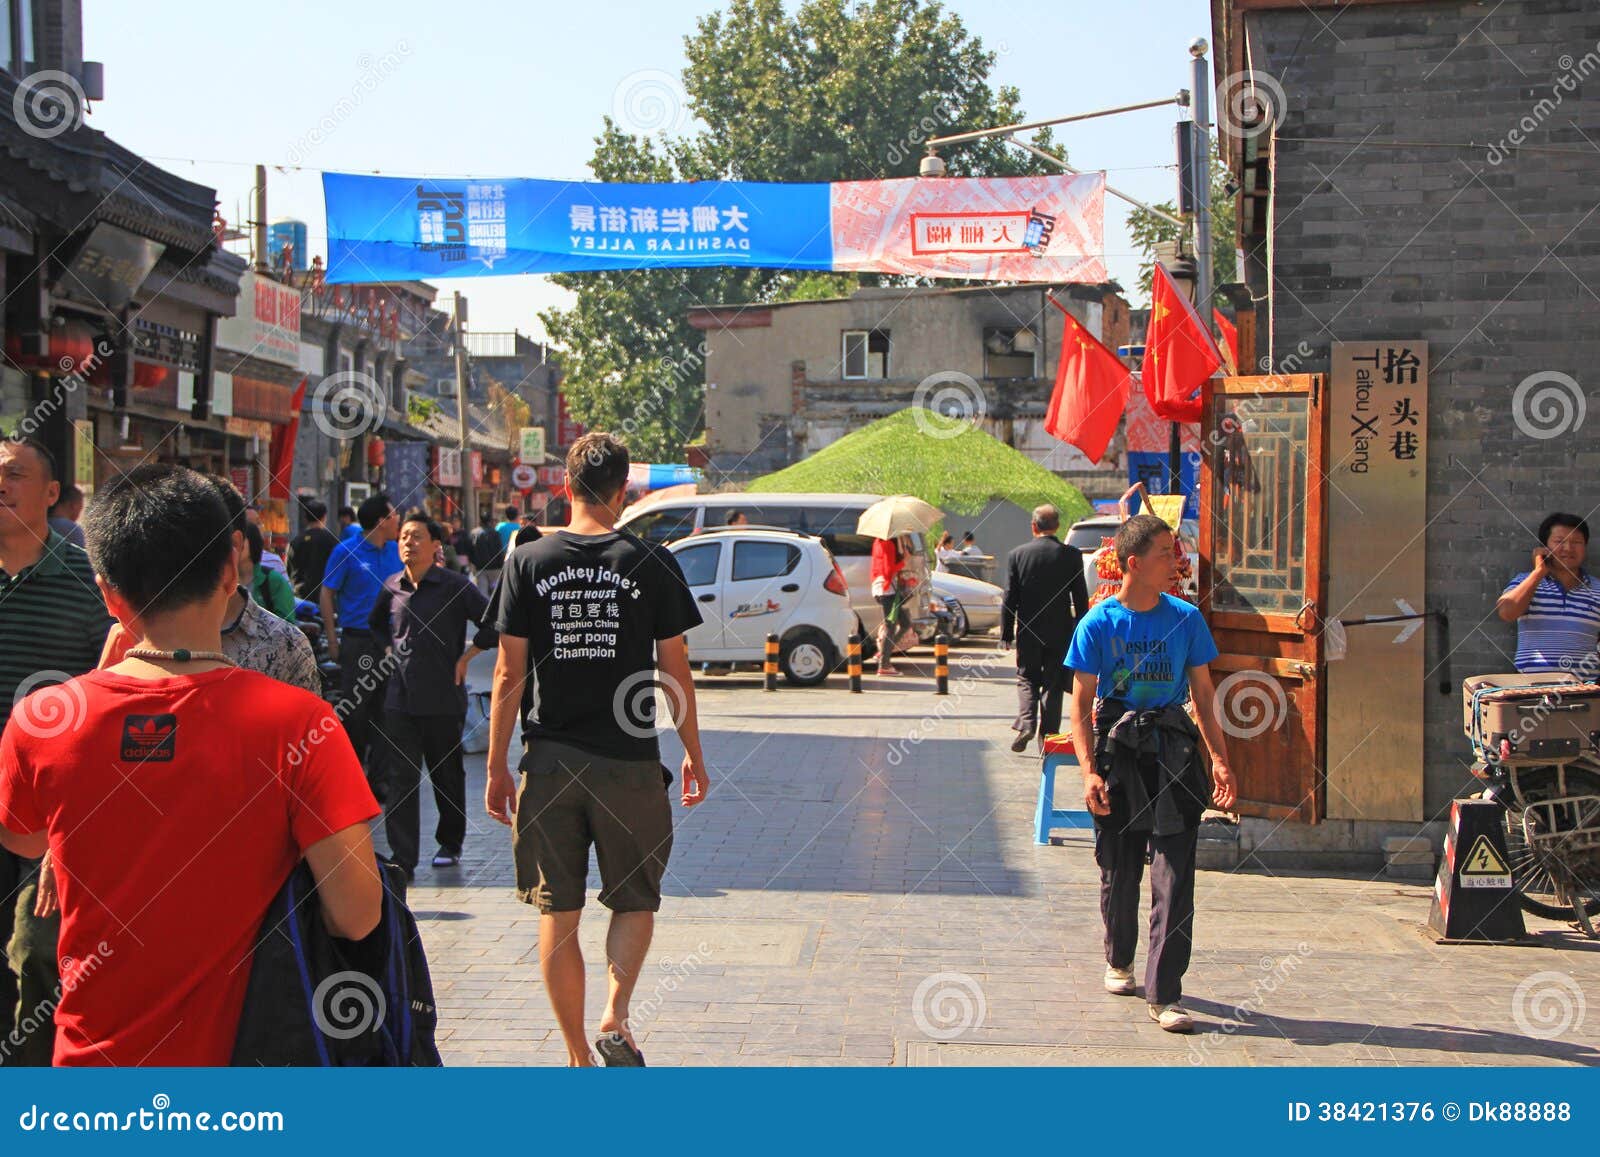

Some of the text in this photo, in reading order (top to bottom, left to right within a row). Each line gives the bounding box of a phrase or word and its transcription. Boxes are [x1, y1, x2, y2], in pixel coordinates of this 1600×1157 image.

[1350, 348, 1379, 474] Taitou Xiang
[1382, 348, 1420, 460] 抬头巷
[535, 566, 641, 600] Monkey jane's
[551, 589, 617, 600] GUEST HOUSE
[551, 602, 620, 619] 背包客栈
[551, 619, 620, 631] Yangshuo China
[554, 632, 617, 645] Beer pong
[1110, 635, 1168, 658] Design
[554, 647, 616, 660] Champion
